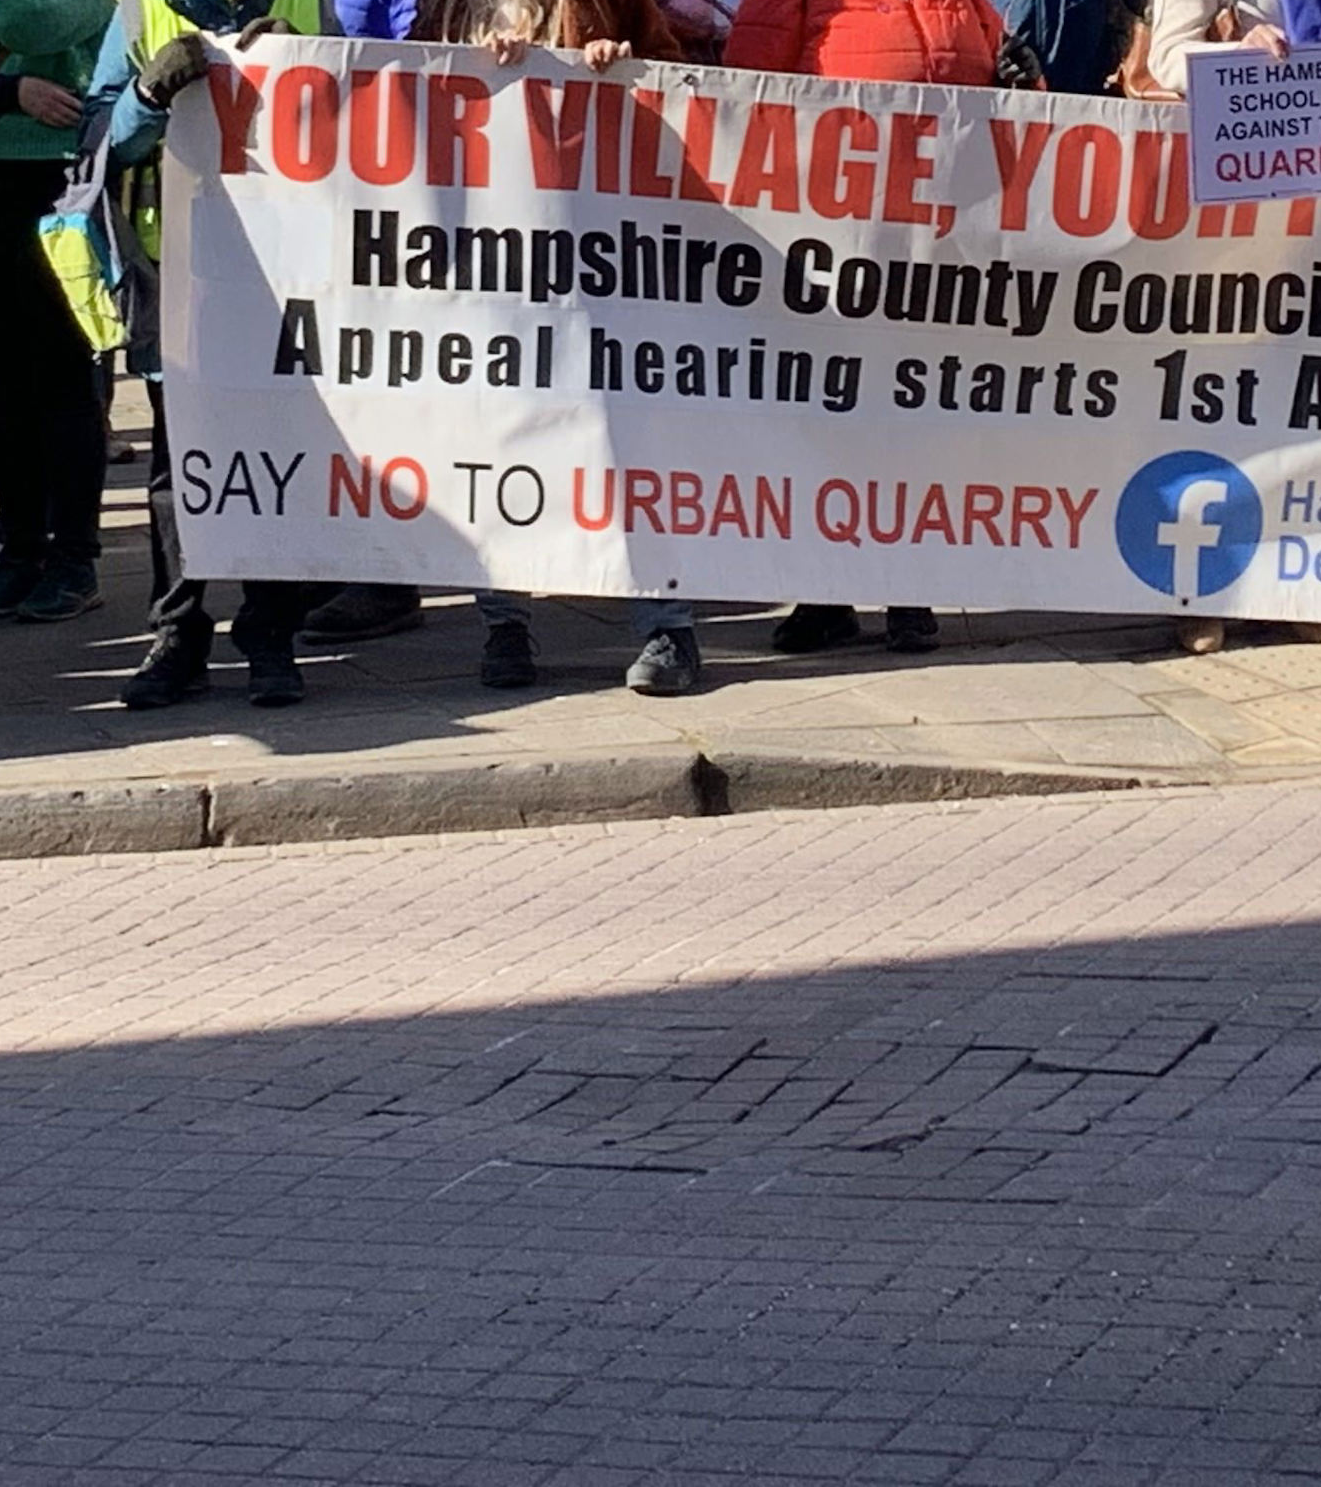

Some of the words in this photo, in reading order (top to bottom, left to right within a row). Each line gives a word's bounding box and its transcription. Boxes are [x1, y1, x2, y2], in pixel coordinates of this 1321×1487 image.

[1215, 66, 1259, 87] THE
[1229, 90, 1320, 114] SCHOOL
[208, 64, 490, 188] YOUR
[522, 75, 957, 239] VILLAGE,
[1215, 117, 1312, 142] AGAINST
[352, 209, 762, 307] Hampshire
[783, 237, 1058, 336] County
[273, 298, 553, 389] Appeal
[589, 327, 862, 413] hearing
[893, 355, 1119, 418] starts
[1154, 349, 1259, 427] 1st
[182, 449, 306, 516] SAY
[328, 453, 429, 521] NO
[453, 462, 545, 527] TO
[573, 467, 792, 541] URBAN
[815, 478, 1100, 549] QUARRY
